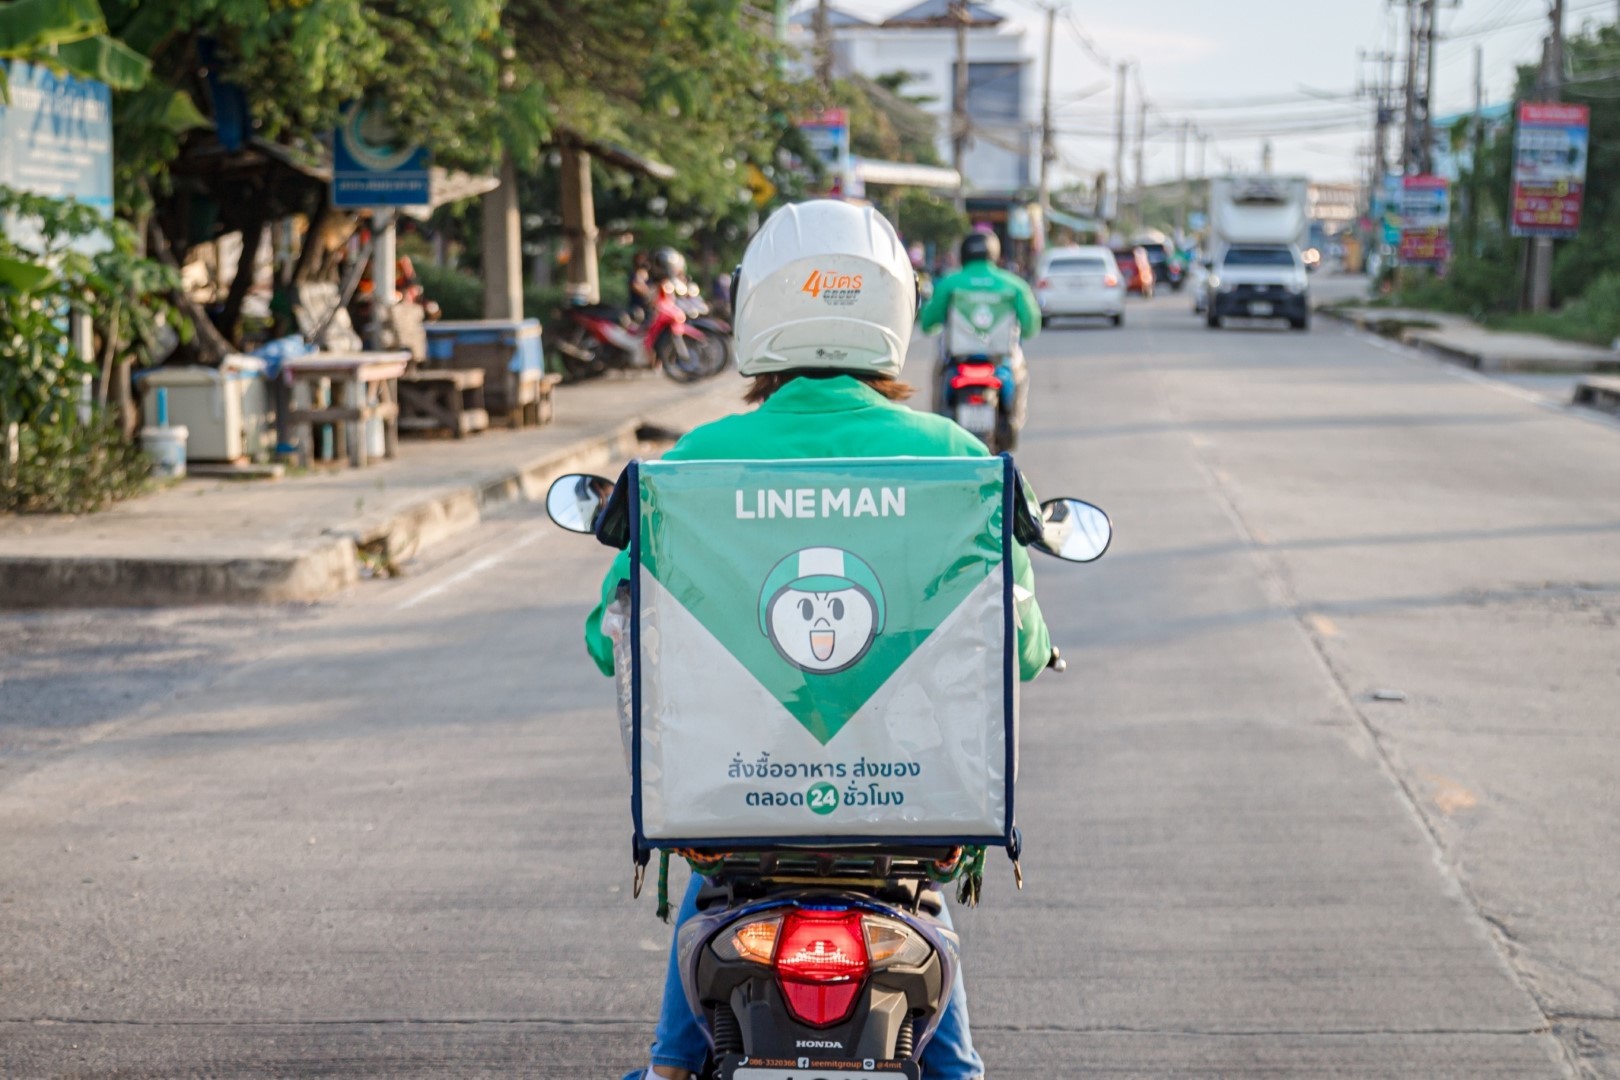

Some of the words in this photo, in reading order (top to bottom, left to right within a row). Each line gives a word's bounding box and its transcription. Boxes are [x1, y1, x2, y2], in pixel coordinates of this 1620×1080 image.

[727, 751, 848, 779] สั่งซื้ออาหาร
[852, 757, 921, 778] ส่งของ
[745, 791, 804, 807] ตลอด
[810, 789, 837, 807] 24
[843, 780, 905, 807] ชั่วโมง
[795, 1040, 843, 1049] HONDA
[810, 1060, 862, 1069] seemitgroup
